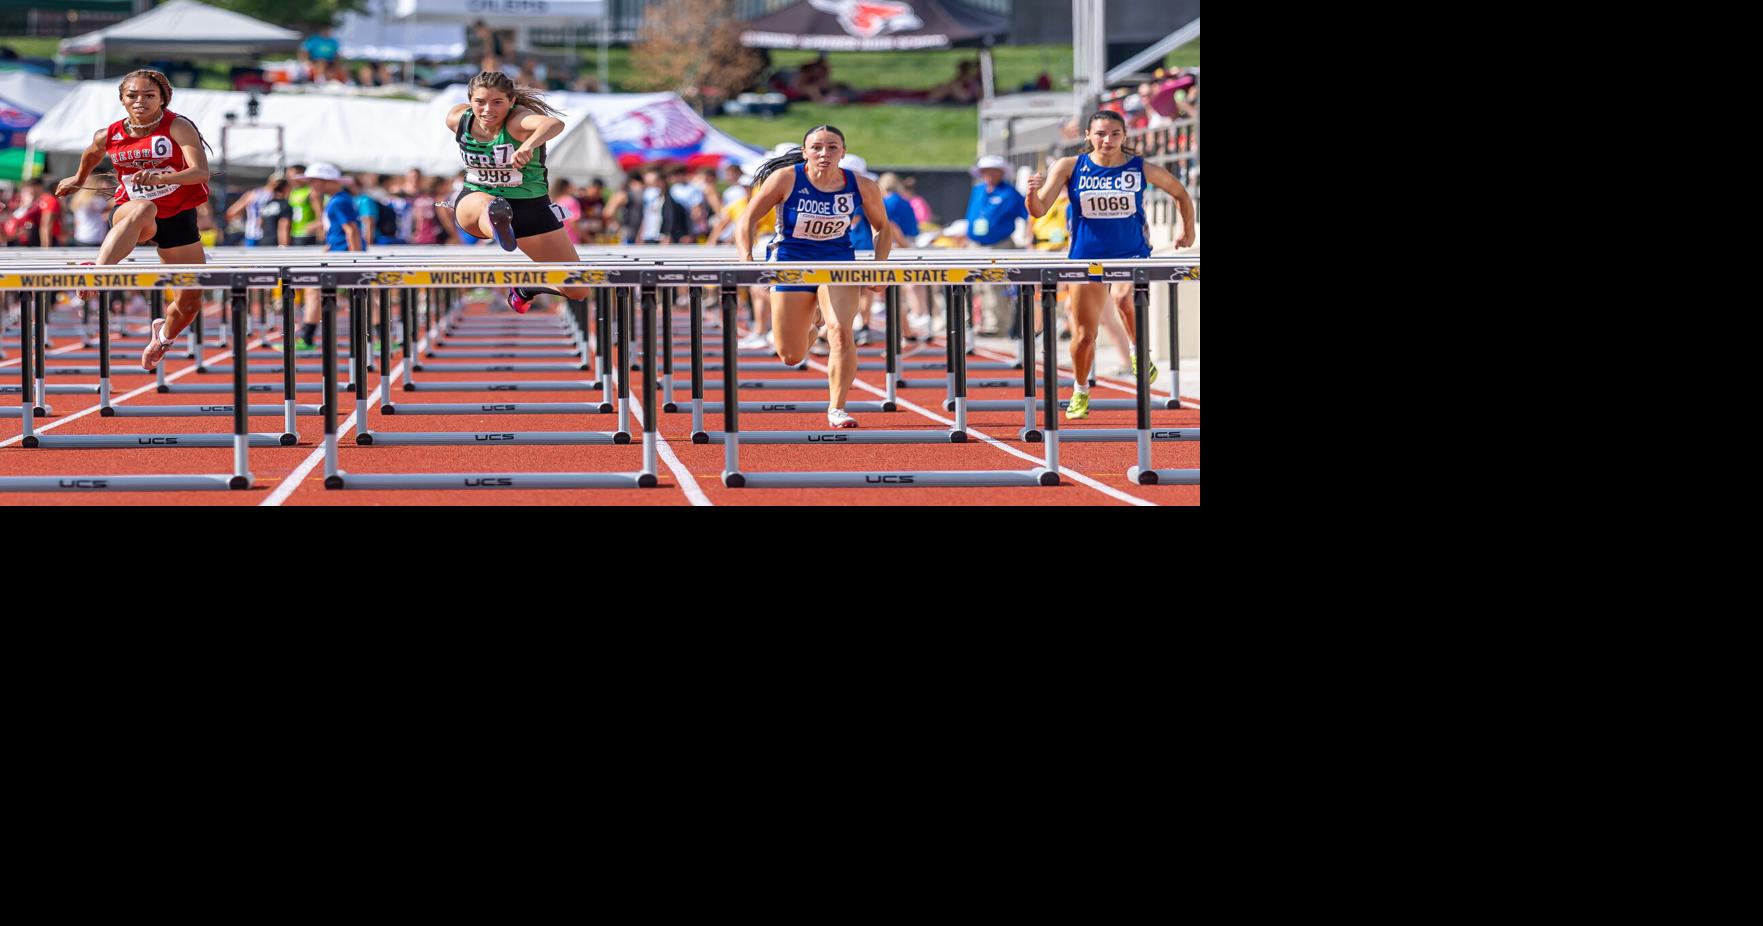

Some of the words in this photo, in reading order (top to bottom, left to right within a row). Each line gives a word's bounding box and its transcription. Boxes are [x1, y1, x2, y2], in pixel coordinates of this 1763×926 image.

[154, 138, 167, 156] 6
[496, 147, 508, 163] 7
[478, 168, 511, 183] 998
[1079, 175, 1112, 189] DODGE
[1124, 173, 1136, 189] 9
[797, 198, 830, 214] DODGE
[837, 196, 849, 213] 8
[1088, 196, 1130, 211] 1069
[551, 204, 566, 219] 7
[804, 220, 845, 235] 1062
[20, 274, 87, 287] WICHITA
[93, 273, 138, 286] STATE
[430, 271, 496, 284] WICHITA
[503, 271, 548, 284] STATE
[830, 270, 896, 282] WICHITA
[903, 270, 948, 282] STATE
[482, 404, 515, 412] UCS
[138, 437, 178, 445] UCS
[475, 433, 514, 441] UCS
[808, 434, 847, 442] UCS
[1151, 431, 1182, 439] CS
[59, 479, 107, 488] UCS
[464, 478, 512, 487] UCS
[865, 475, 914, 483] UCS
